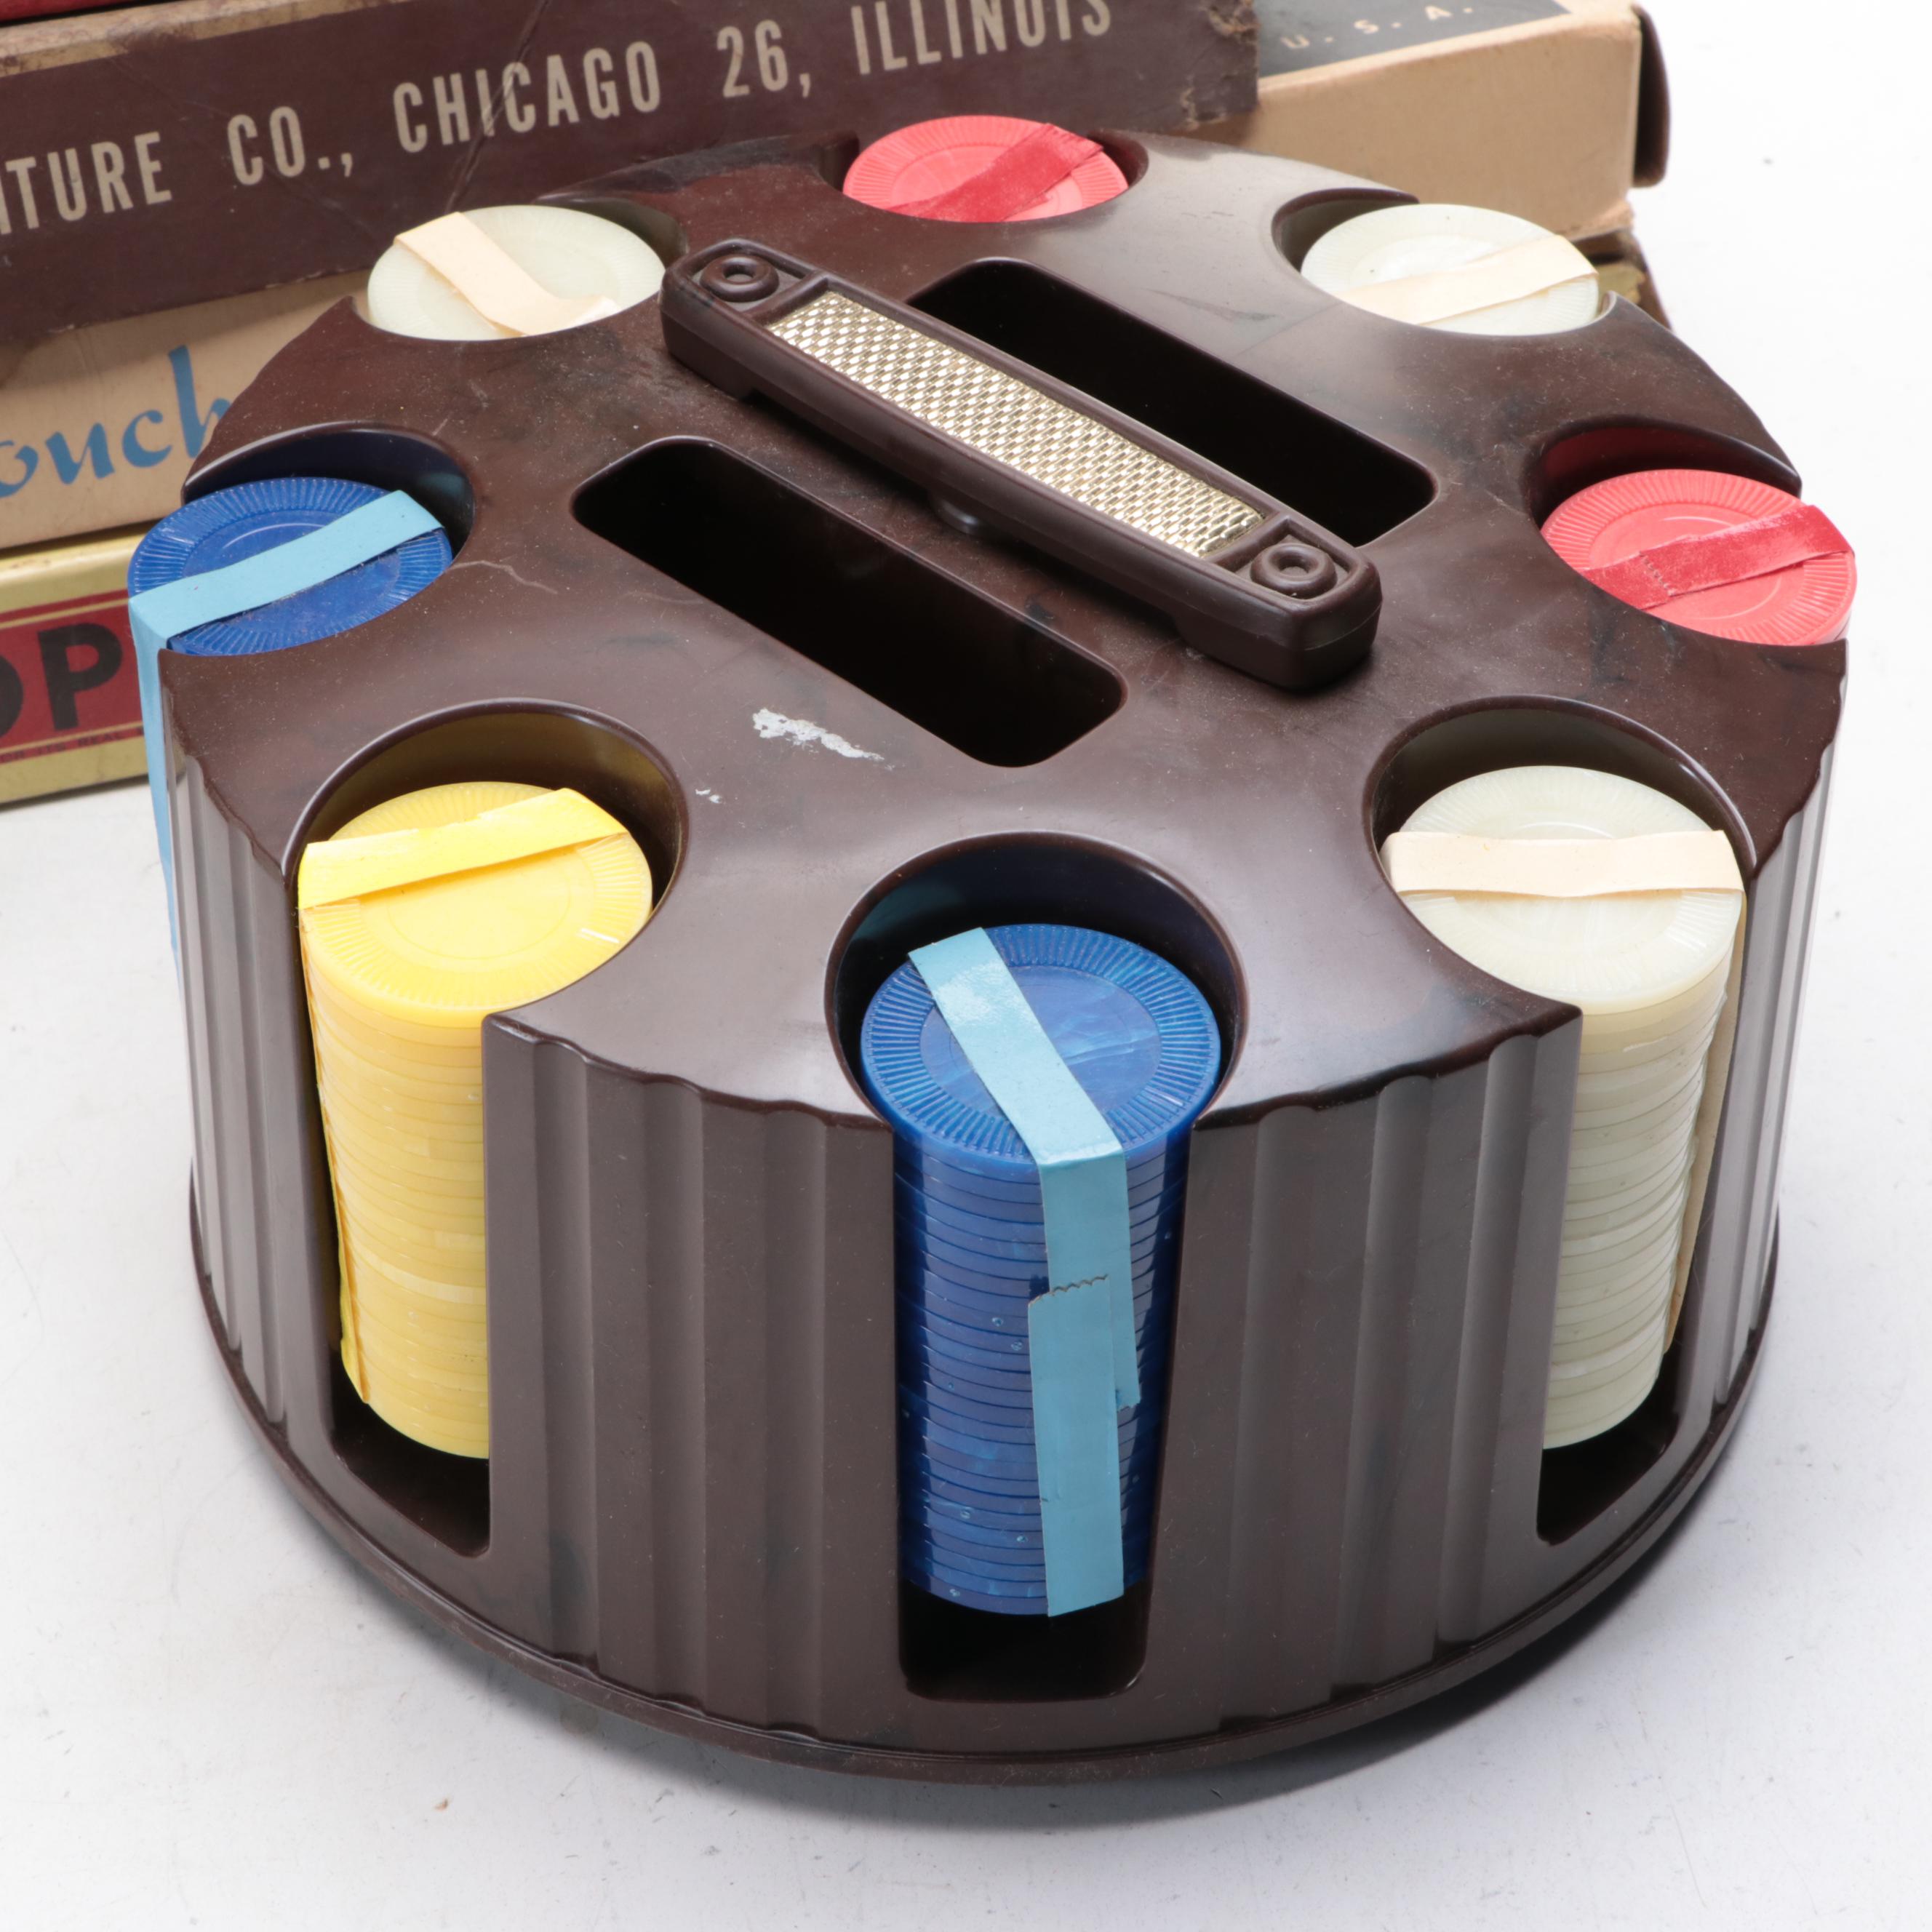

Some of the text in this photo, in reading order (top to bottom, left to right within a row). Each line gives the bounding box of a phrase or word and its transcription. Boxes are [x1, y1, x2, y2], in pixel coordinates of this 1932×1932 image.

[227, 105, 354, 185] CO.,
[393, 40, 660, 153] CHICAGO
[716, 19, 811, 98] 26,
[850, 0, 1111, 75] ILLINOIS
